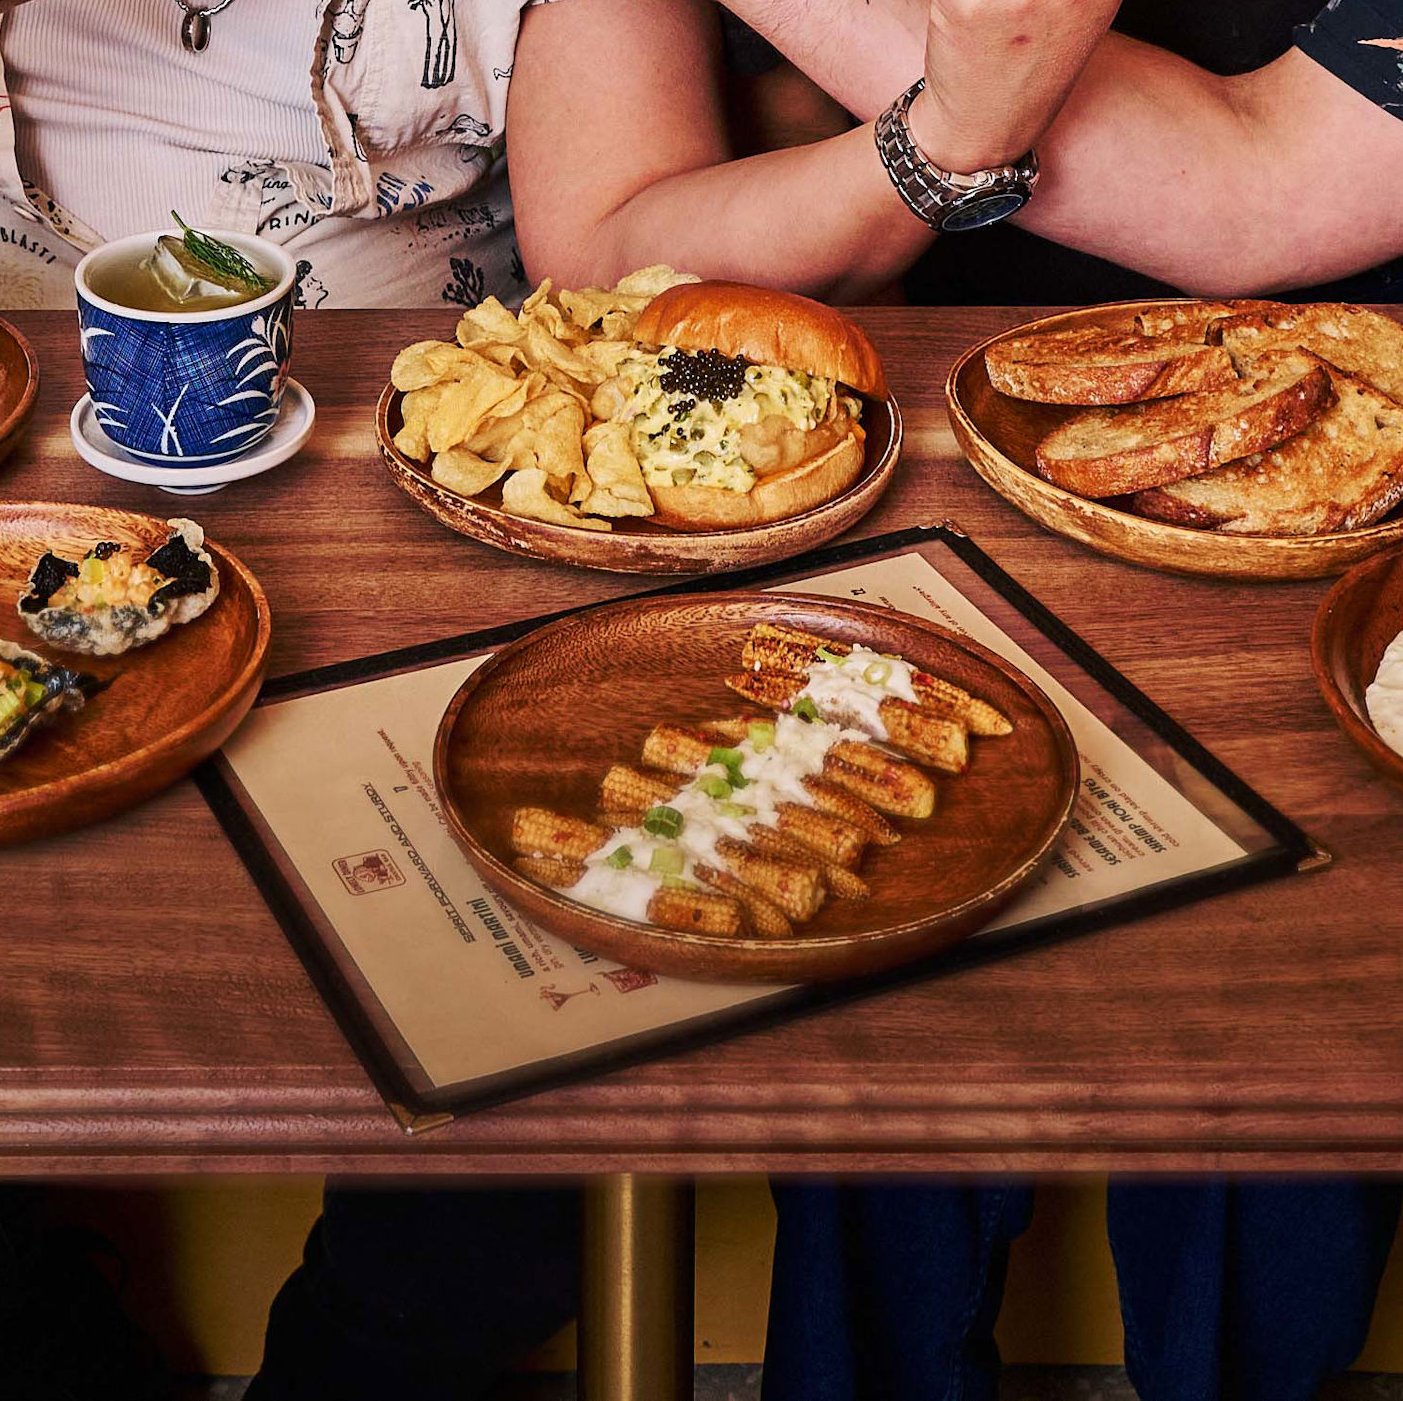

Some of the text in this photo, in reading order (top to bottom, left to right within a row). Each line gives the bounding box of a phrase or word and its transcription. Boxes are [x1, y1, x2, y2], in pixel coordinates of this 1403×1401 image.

[392, 753, 408, 768] upon
[1089, 763, 1112, 784] crispy
[415, 784, 431, 802] made
[1109, 782, 1121, 792] on
[361, 783, 394, 822] STURDY
[1117, 791, 1140, 811] salad
[1099, 814, 1123, 835] green
[1137, 809, 1165, 834] shrimp
[389, 824, 409, 846] AND
[1160, 832, 1180, 848] cold
[1083, 833, 1121, 867] SESAME
[406, 848, 450, 906] FORWARD
